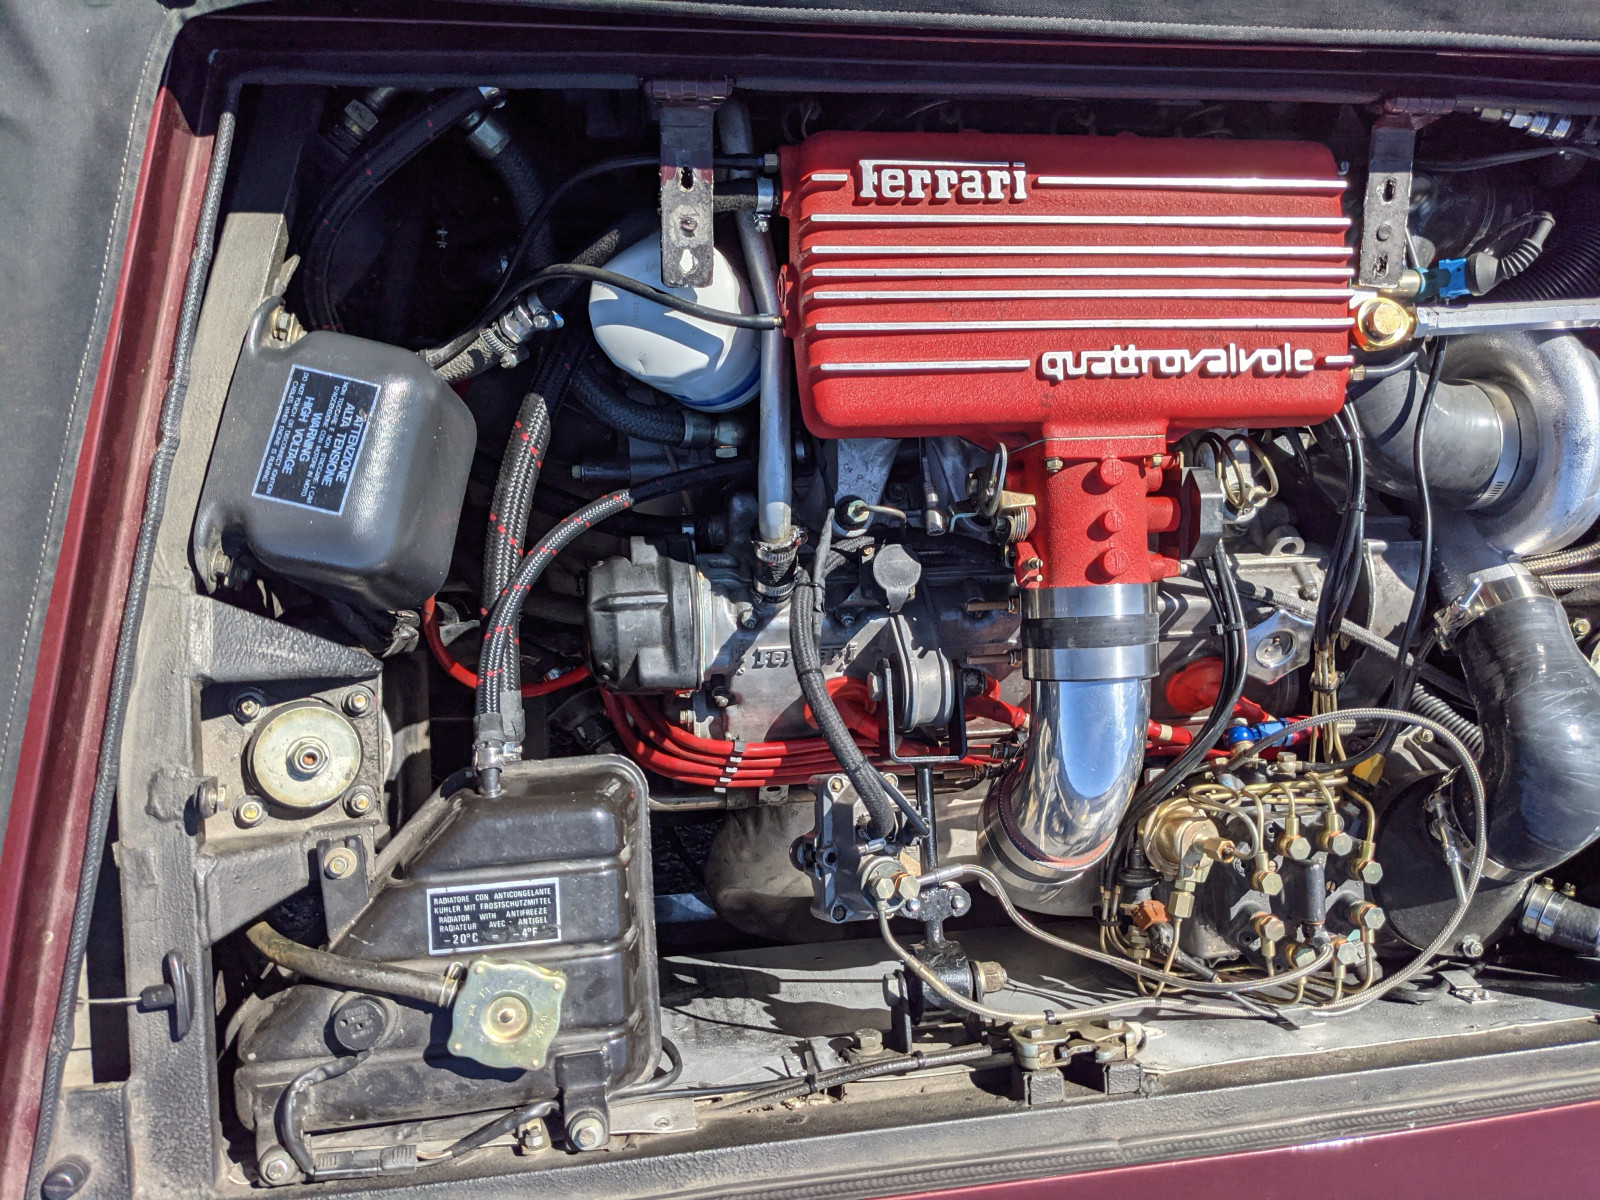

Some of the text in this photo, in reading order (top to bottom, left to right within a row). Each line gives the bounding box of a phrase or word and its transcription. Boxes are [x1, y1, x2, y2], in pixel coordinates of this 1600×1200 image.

[859, 160, 1027, 199] Ferrari
[1041, 343, 1314, 381] quattrovalvole
[286, 380, 298, 403] CABLES
[339, 381, 348, 395] NON
[280, 405, 290, 423] WHEN
[330, 396, 344, 425] TOCCARE
[266, 371, 309, 494] DO NOT TOUCH OR DISCONNECT IGNITION
[272, 424, 284, 446] ENGINE
[281, 395, 314, 475] HIGH VOLTAGE
[298, 411, 323, 462] WARNING
[316, 429, 326, 443] CON
[323, 434, 332, 448] NON
[320, 402, 356, 487] ALTA TENSIONE
[335, 414, 365, 483] ATTENZIONE
[308, 444, 321, 469] MOTORE
[433, 887, 551, 905] RADIATORE CON ANTICONGELANTE
[463, 903, 475, 911] MIT
[480, 896, 551, 910] FROSTSCHUTZMITTEL
[438, 906, 547, 924] RADIATOR WITH ANTIFREEZE
[439, 915, 547, 933] RADIATEUR AVEC ANTIGEL
